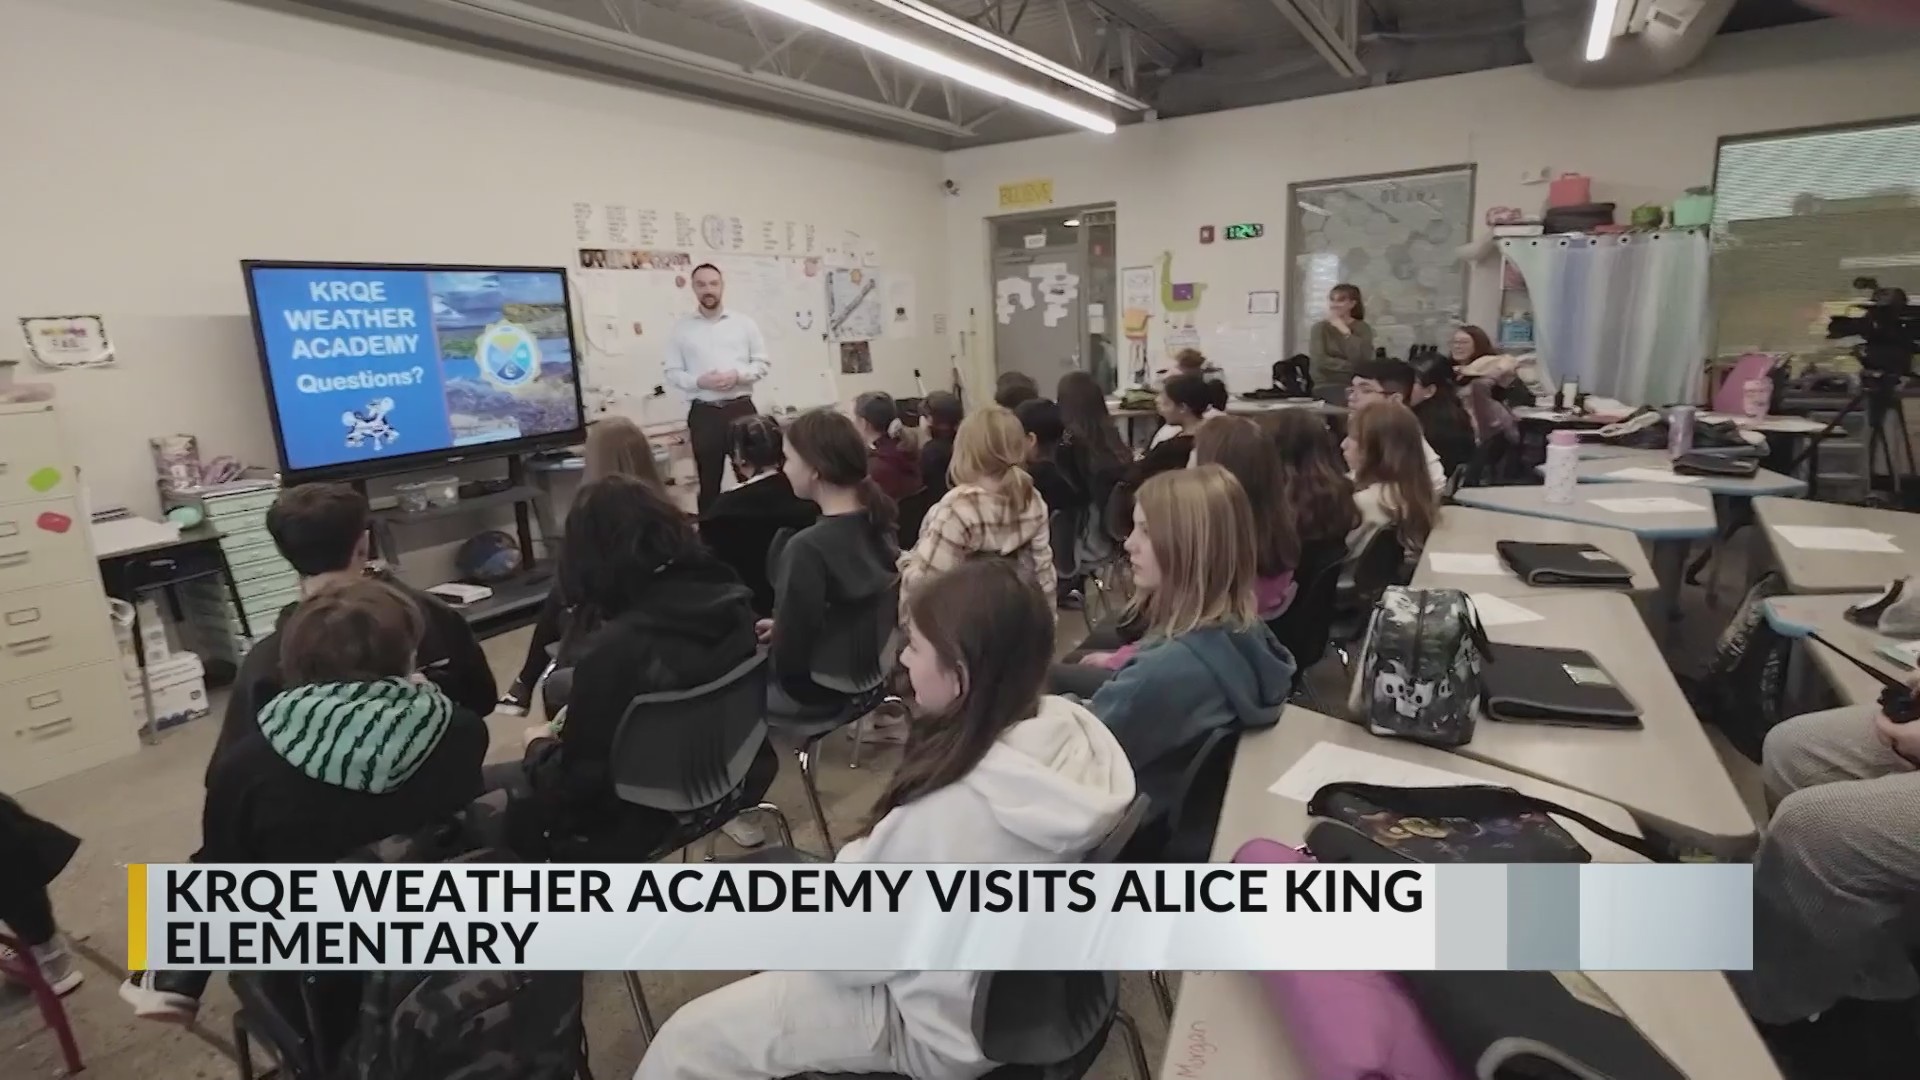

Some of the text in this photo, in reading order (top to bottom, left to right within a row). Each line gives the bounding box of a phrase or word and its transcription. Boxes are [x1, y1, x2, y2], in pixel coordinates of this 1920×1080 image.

[309, 281, 387, 303] KRQE
[284, 308, 416, 331] WEATHER
[291, 334, 419, 360] ACADEMY
[296, 366, 424, 394] Questions?
